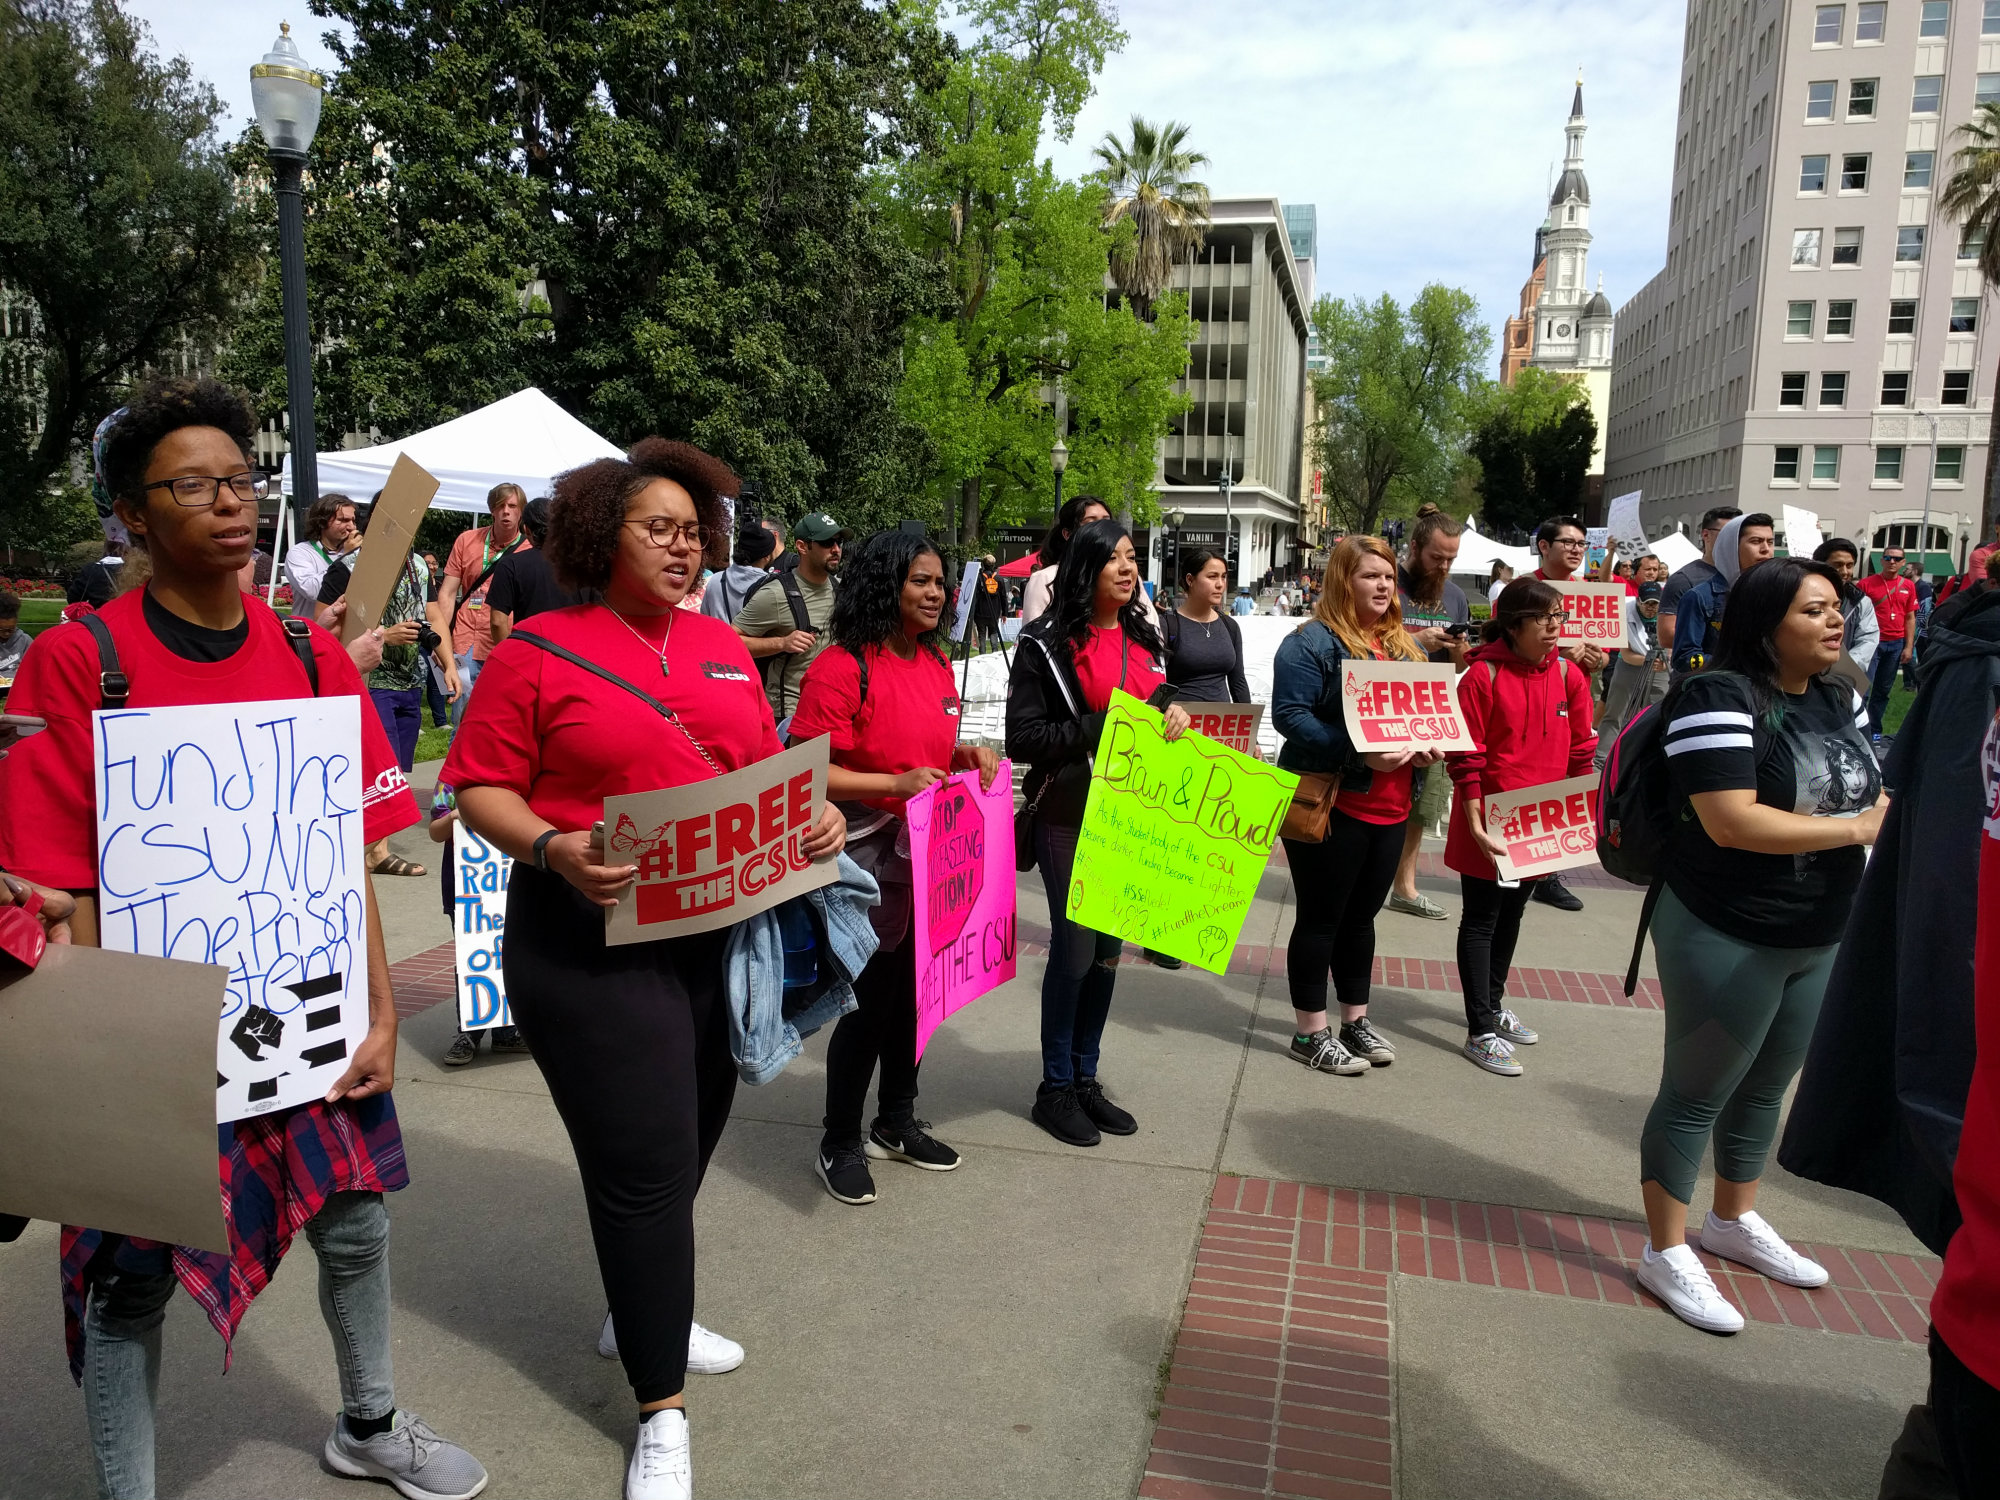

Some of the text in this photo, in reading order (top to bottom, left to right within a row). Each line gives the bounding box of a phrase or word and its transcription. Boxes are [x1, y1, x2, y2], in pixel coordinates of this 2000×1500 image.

[1186, 533, 1213, 542] VANINI
[1402, 617, 1431, 627] CALIFORNIA
[1563, 594, 1619, 619] FREE
[1563, 621, 1621, 639] THE CSU
[725, 672, 750, 681] CSU
[1357, 680, 1454, 717] #FREE
[1188, 714, 1254, 737] FREE
[1379, 717, 1461, 742] THE CSU
[100, 712, 359, 821] Fund The
[374, 765, 407, 793] CFA
[1172, 766, 1193, 810] &
[635, 768, 813, 881] #FREE
[933, 794, 966, 841] STOP
[1095, 803, 1108, 824] As
[1111, 805, 1124, 831] the
[1170, 838, 1184, 854] of
[1185, 841, 1200, 864] the
[100, 811, 347, 898] CSU NOT
[1527, 837, 1559, 858] THE
[676, 825, 814, 911] THE CSU
[107, 892, 239, 965] The
[982, 911, 1016, 974] CSU
